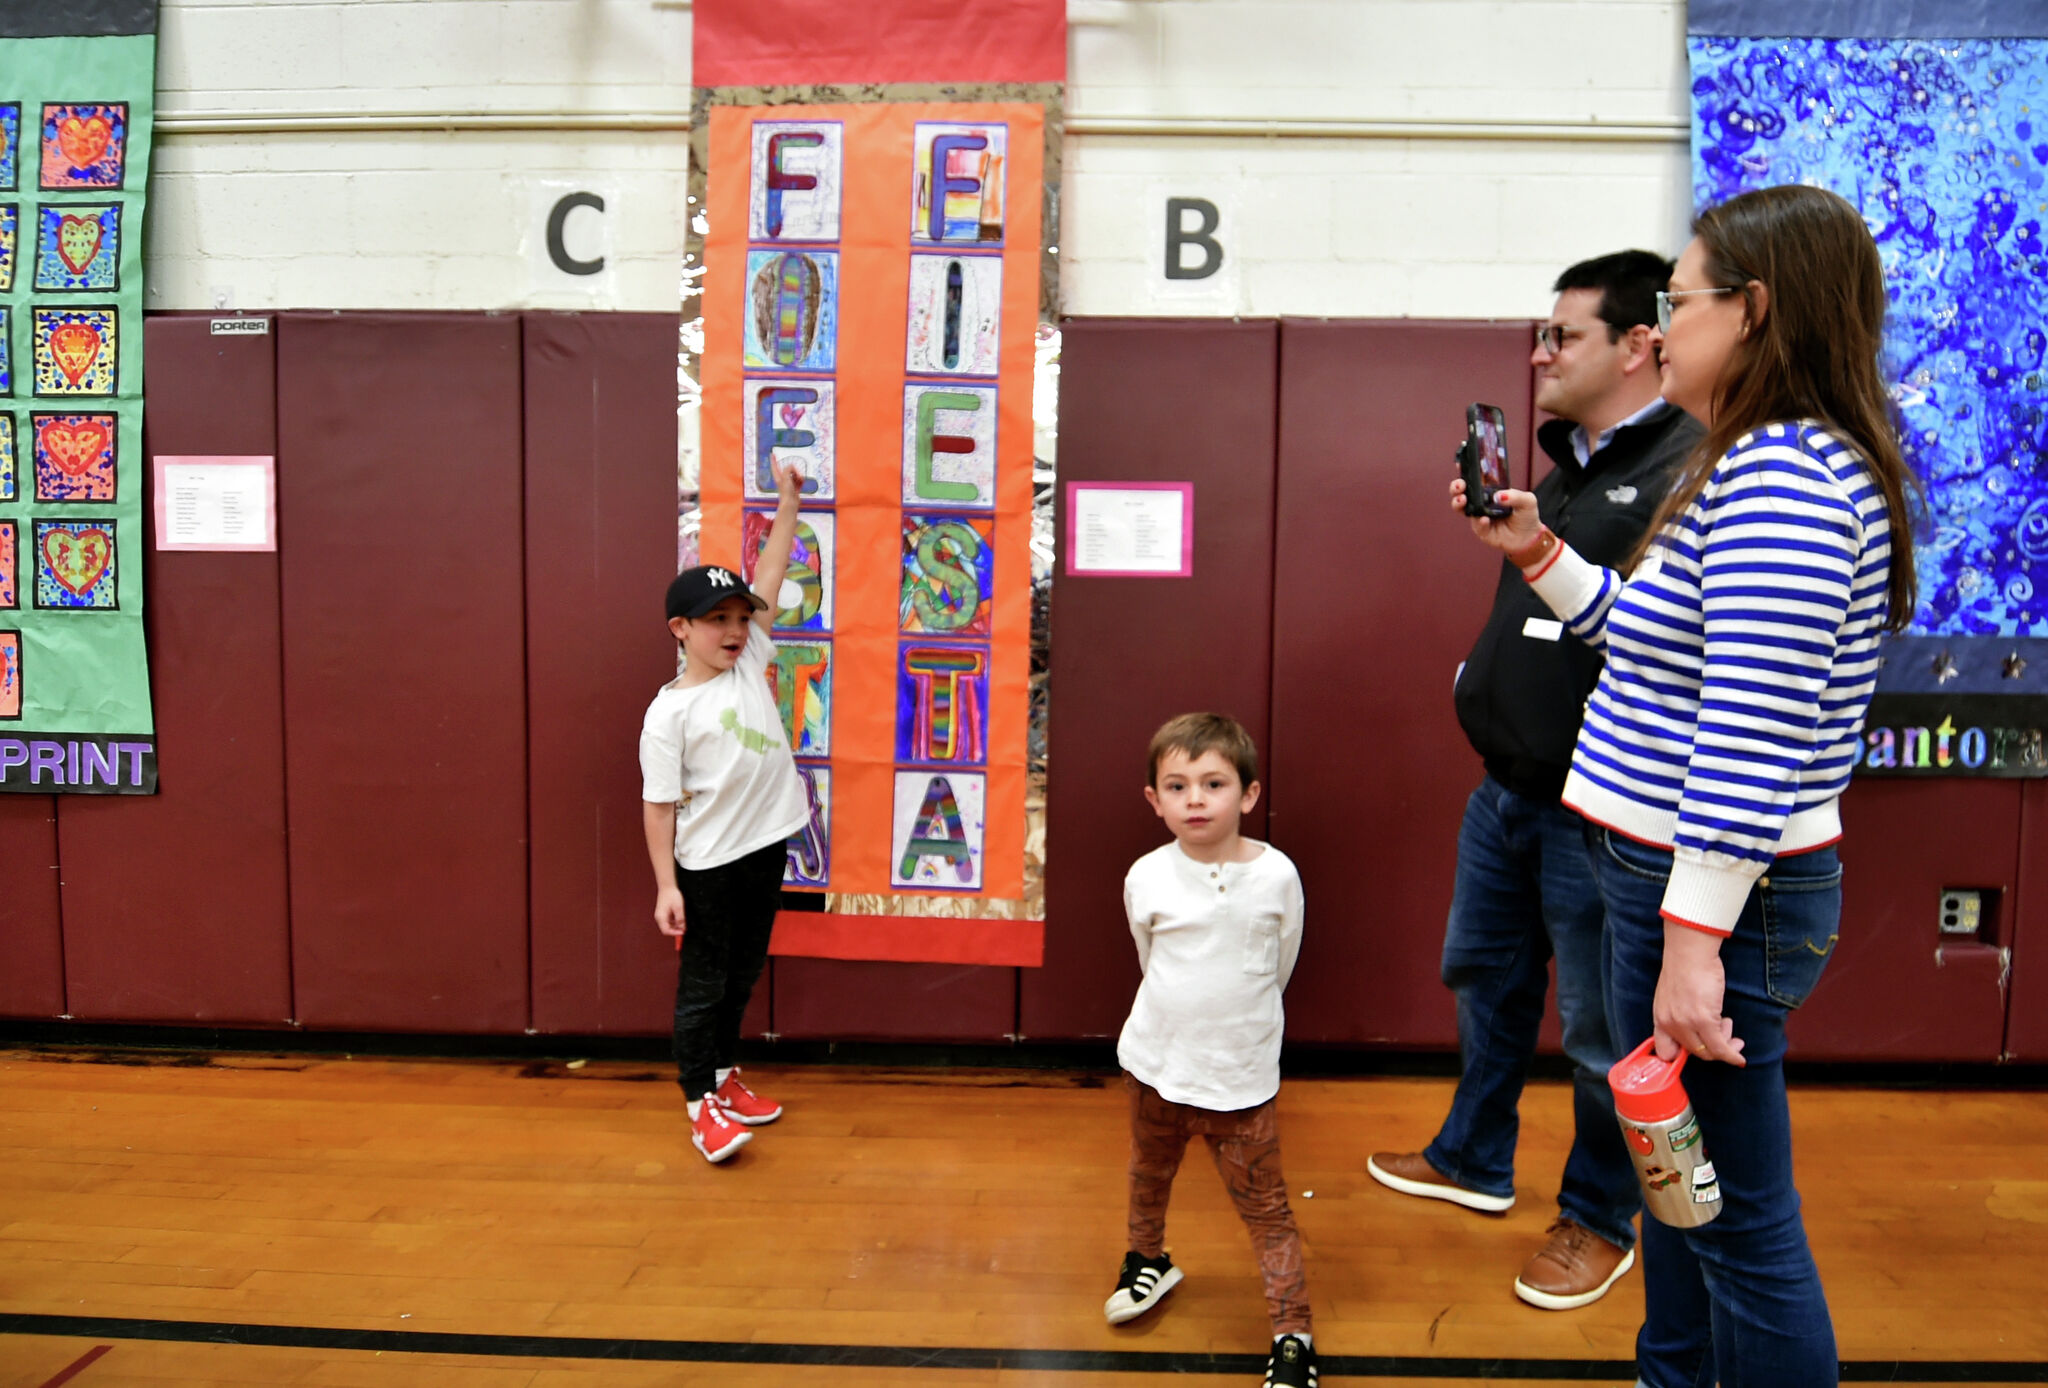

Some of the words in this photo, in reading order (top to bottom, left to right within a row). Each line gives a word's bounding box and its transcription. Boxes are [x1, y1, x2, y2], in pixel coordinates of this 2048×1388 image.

[546, 191, 604, 275] C
[1165, 197, 1224, 279] B
[706, 567, 735, 587] NY
[0, 738, 153, 786] PRINT
[1852, 714, 2048, 769] antora
